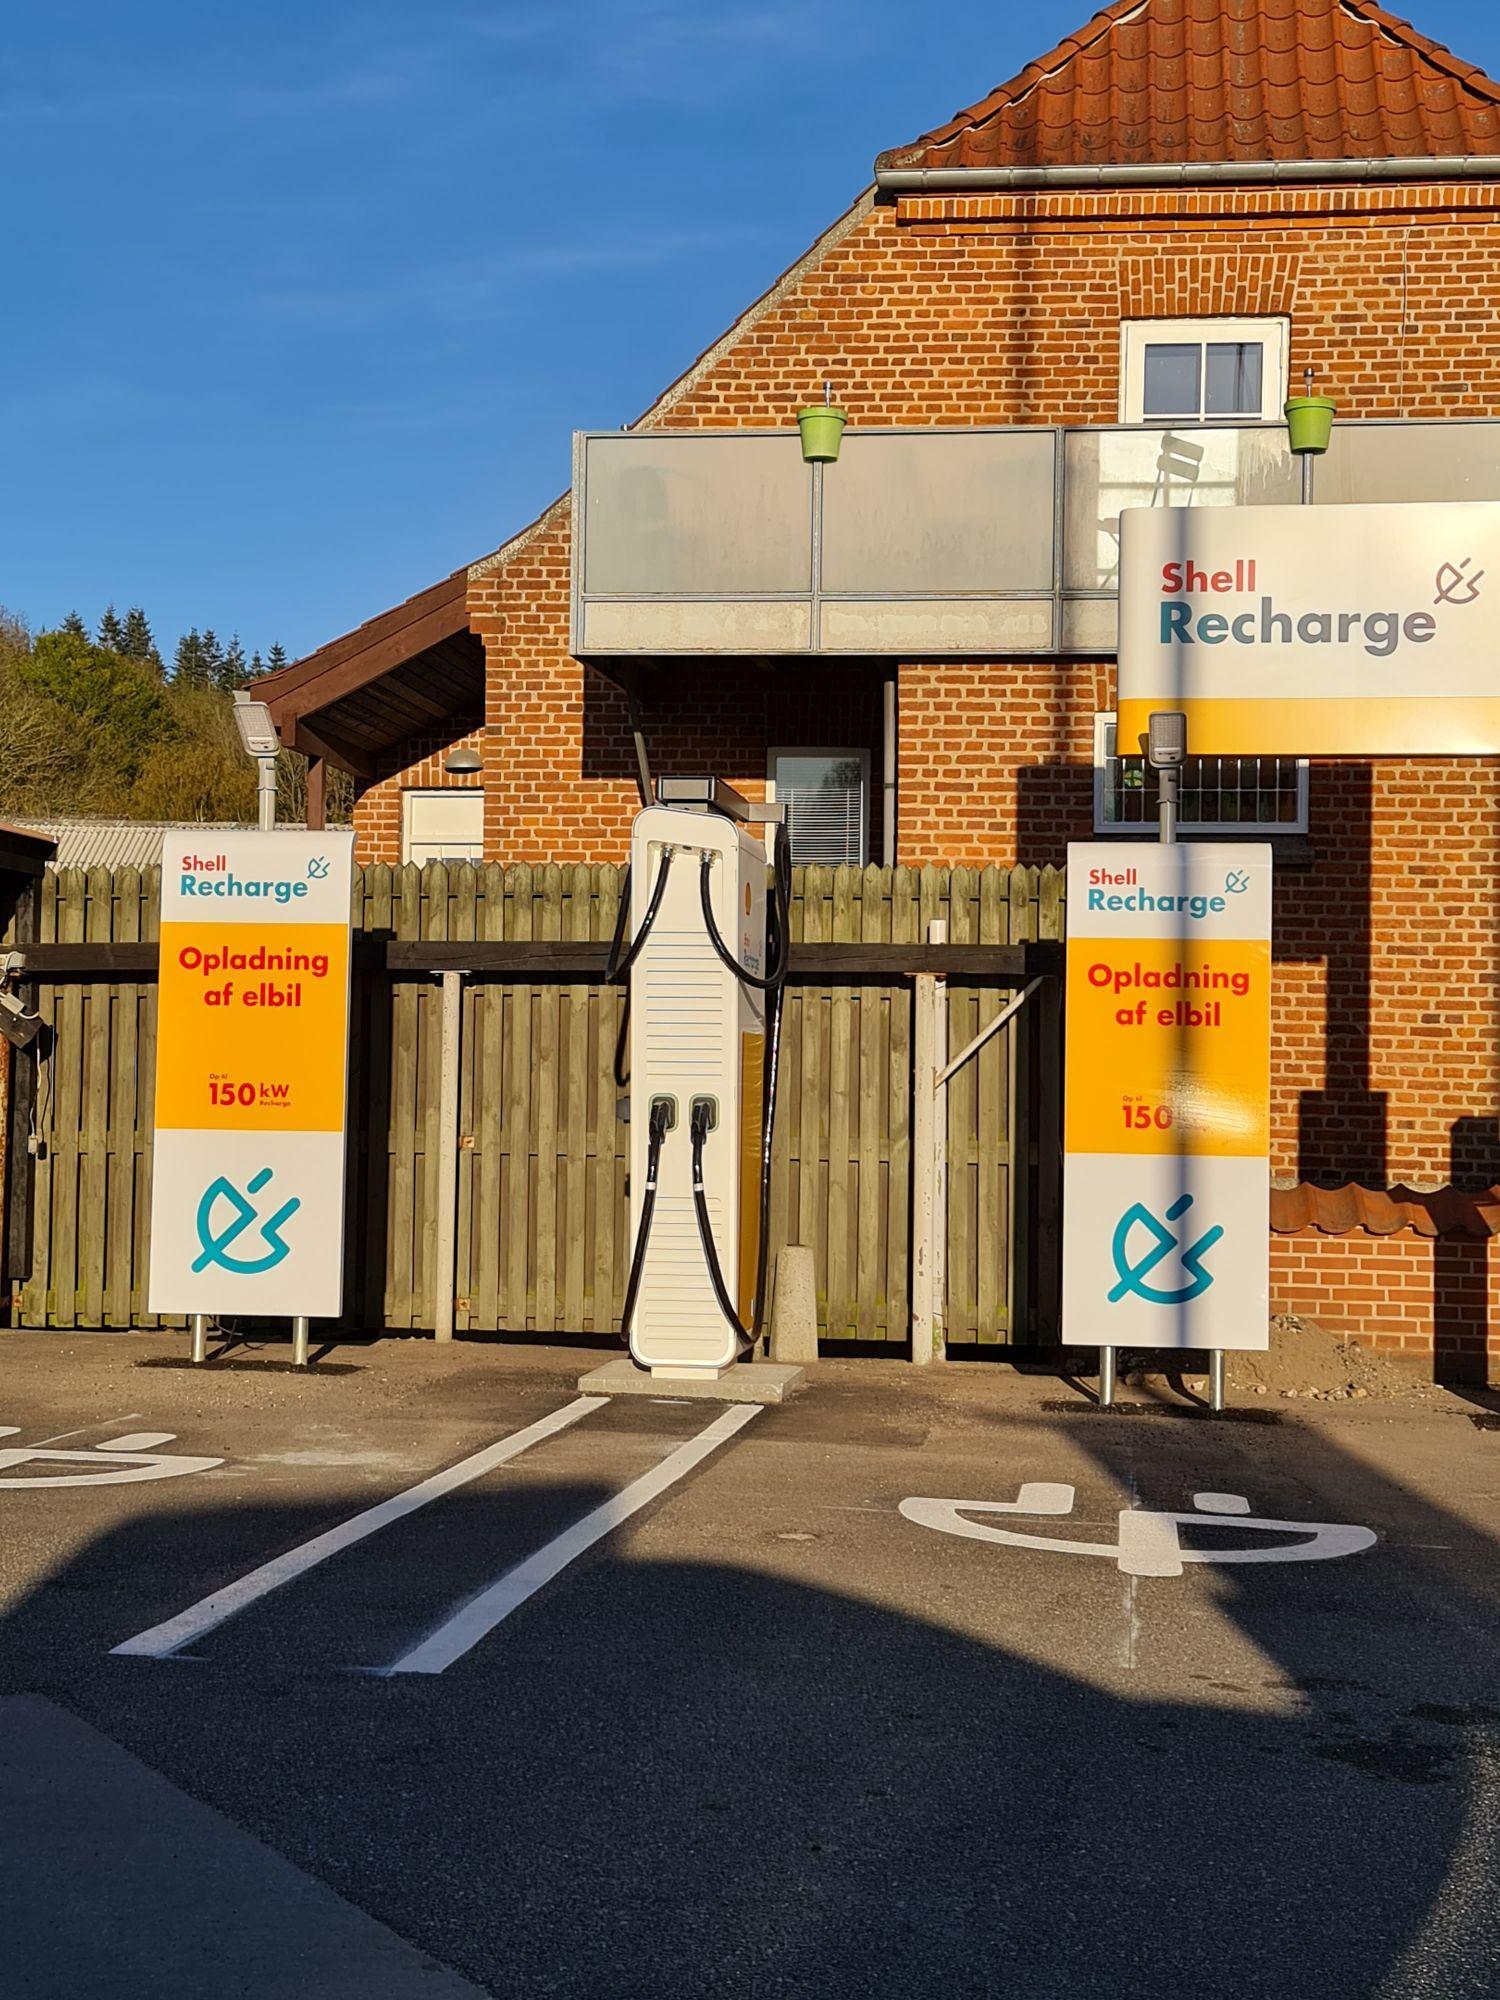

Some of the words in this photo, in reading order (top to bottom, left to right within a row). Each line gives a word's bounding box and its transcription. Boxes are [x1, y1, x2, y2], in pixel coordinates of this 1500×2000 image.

[1161, 559, 1256, 593] Shell
[1160, 597, 1437, 657] Recharge
[181, 855, 226, 871] Shell
[1088, 868, 1137, 885] Shell
[180, 874, 308, 903] Recharge
[1088, 888, 1226, 919] Recharge
[179, 946, 329, 977] Opladning
[1088, 963, 1250, 996] Opladning
[204, 982, 234, 1007] af
[243, 983, 301, 1007] elbil
[1115, 1001, 1147, 1026] af
[1157, 1001, 1221, 1027] elbil
[209, 1083, 256, 1106] 150
[260, 1083, 290, 1098] kW
[1122, 1105, 1173, 1130] 150
